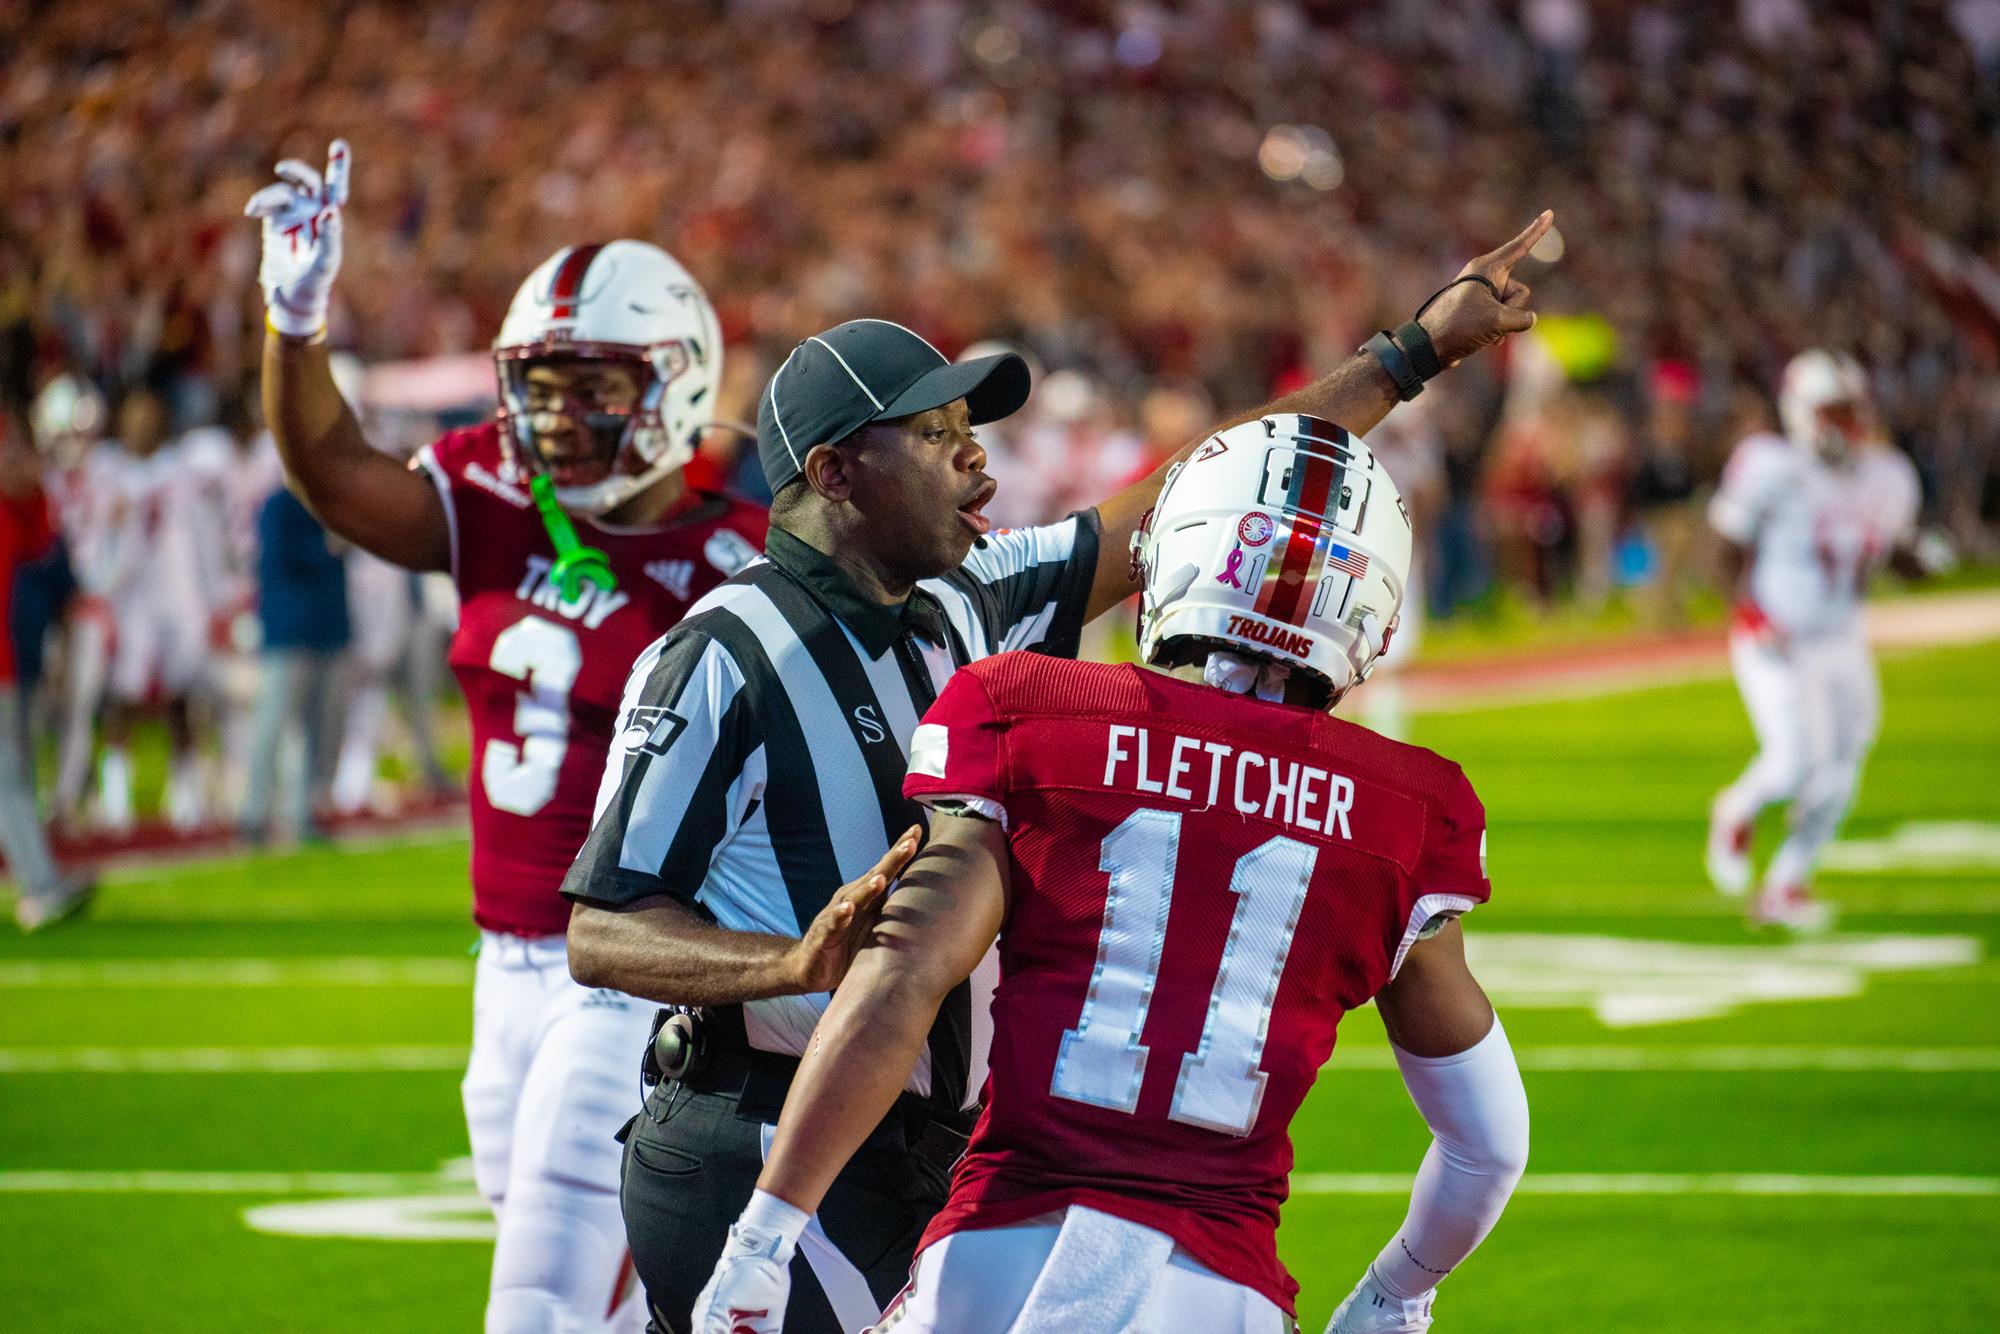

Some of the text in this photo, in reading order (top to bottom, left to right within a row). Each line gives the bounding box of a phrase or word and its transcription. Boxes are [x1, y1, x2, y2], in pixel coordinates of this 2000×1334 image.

[482, 615, 583, 816] 3
[1226, 615, 1314, 658] TROJANS
[1104, 724, 1354, 839] FLETCHER
[1050, 808, 1319, 1138] 11
